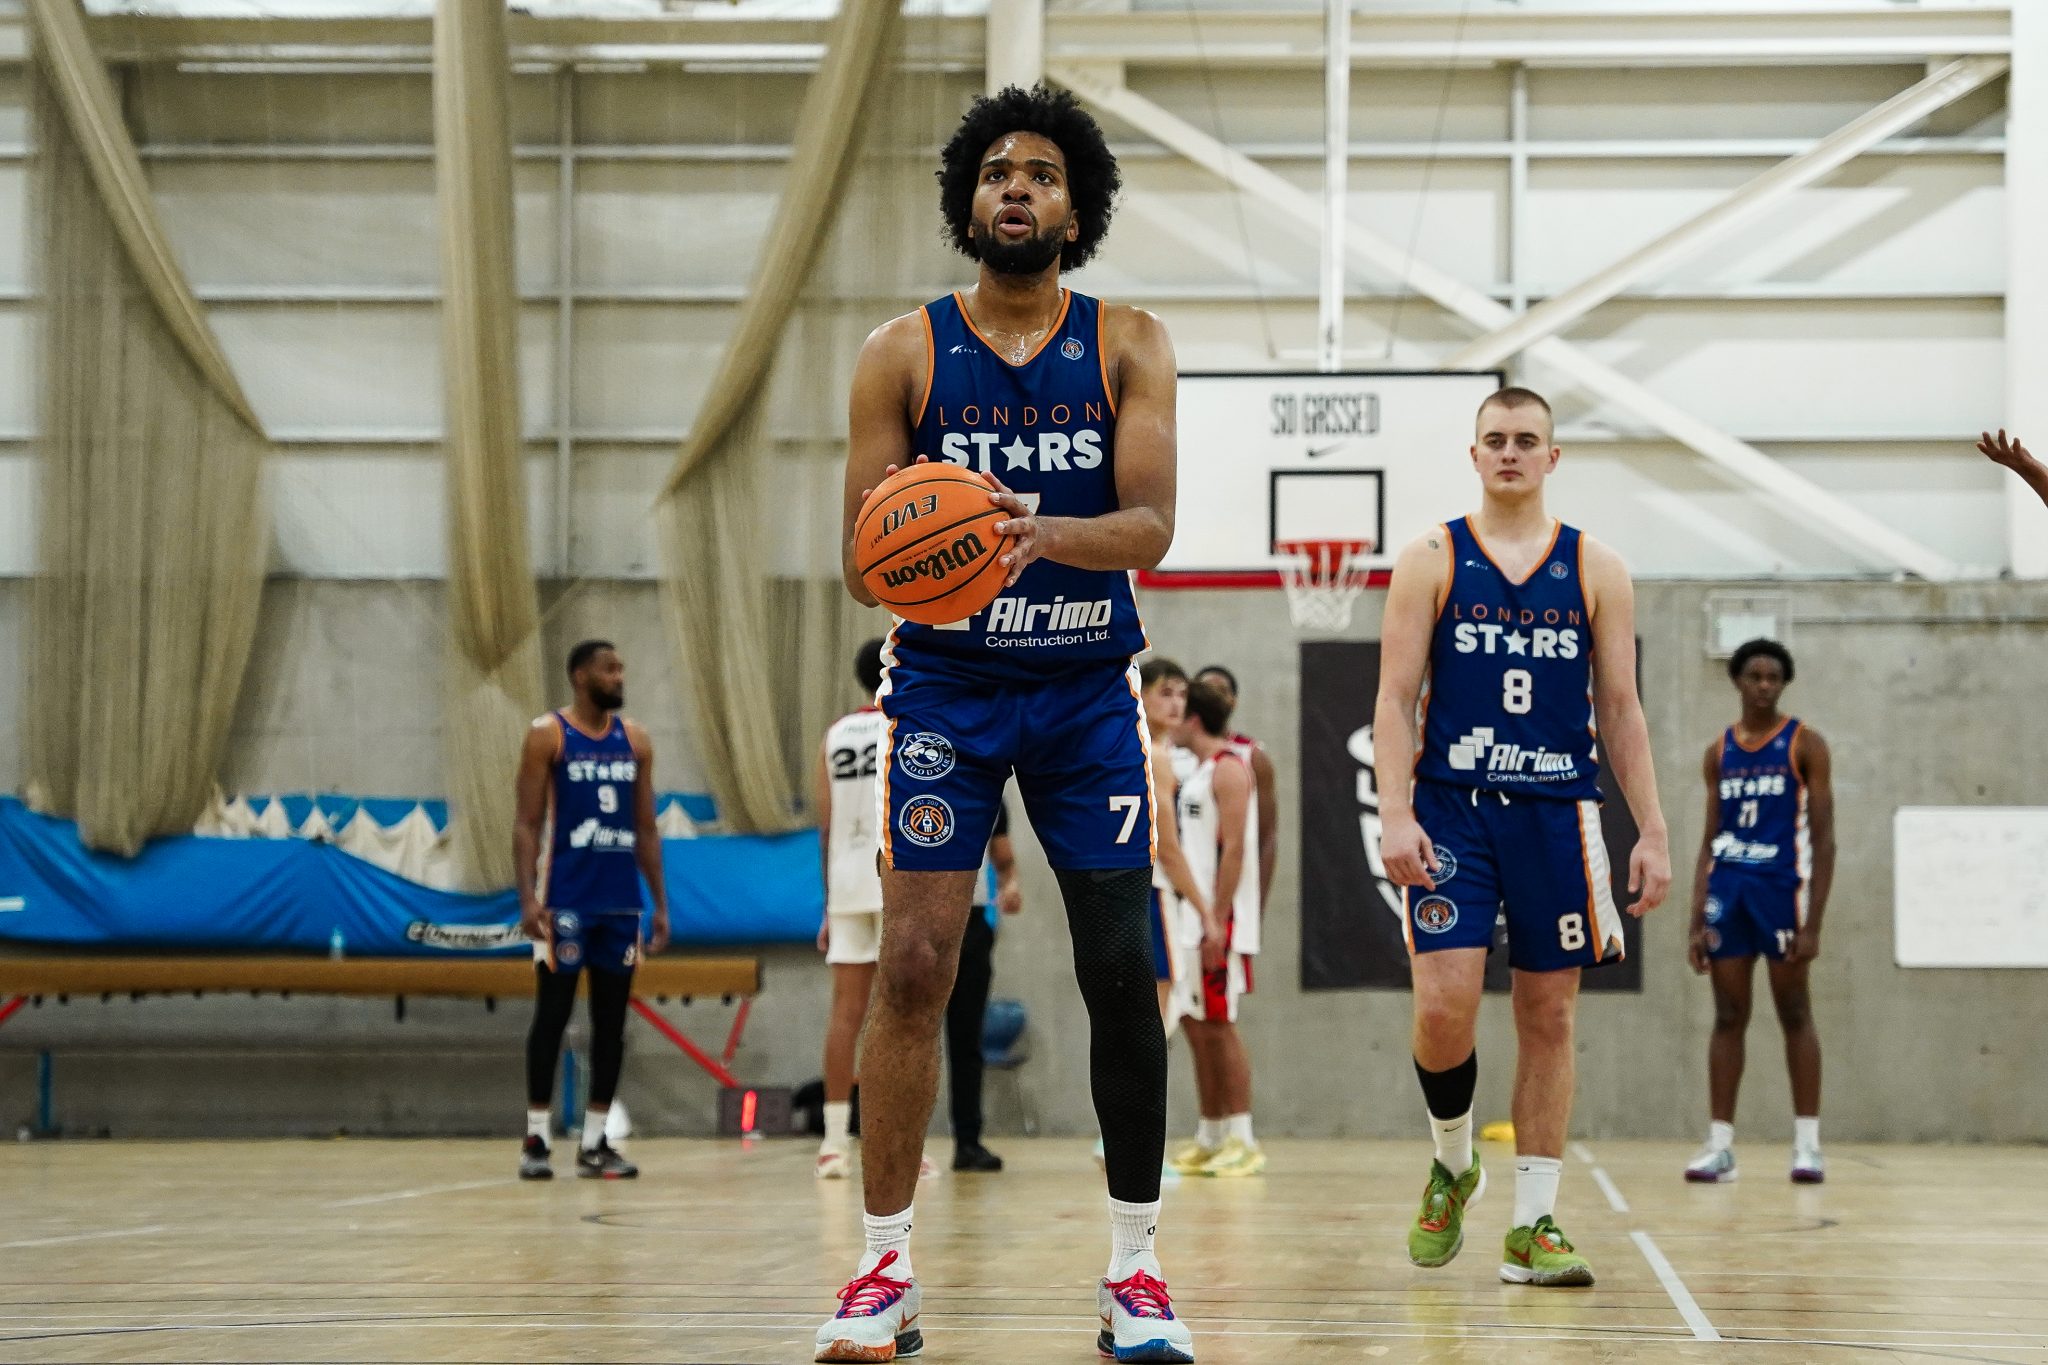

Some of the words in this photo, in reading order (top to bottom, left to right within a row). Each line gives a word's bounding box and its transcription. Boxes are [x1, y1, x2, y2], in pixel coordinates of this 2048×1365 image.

[939, 401, 1102, 426] LONDON
[882, 494, 938, 536] EVO
[880, 532, 987, 588] Wilson
[987, 595, 1112, 633] Alrimo
[1453, 603, 1581, 626] LONDON
[985, 632, 1083, 648] Construction
[1087, 629, 1111, 642] Ltd.
[1502, 668, 1532, 715] 8
[1487, 743, 1574, 772] Alrimo
[597, 785, 619, 814] 9
[904, 824, 930, 842] LONDON
[1108, 795, 1141, 844] 7
[1557, 912, 1586, 951] 8
